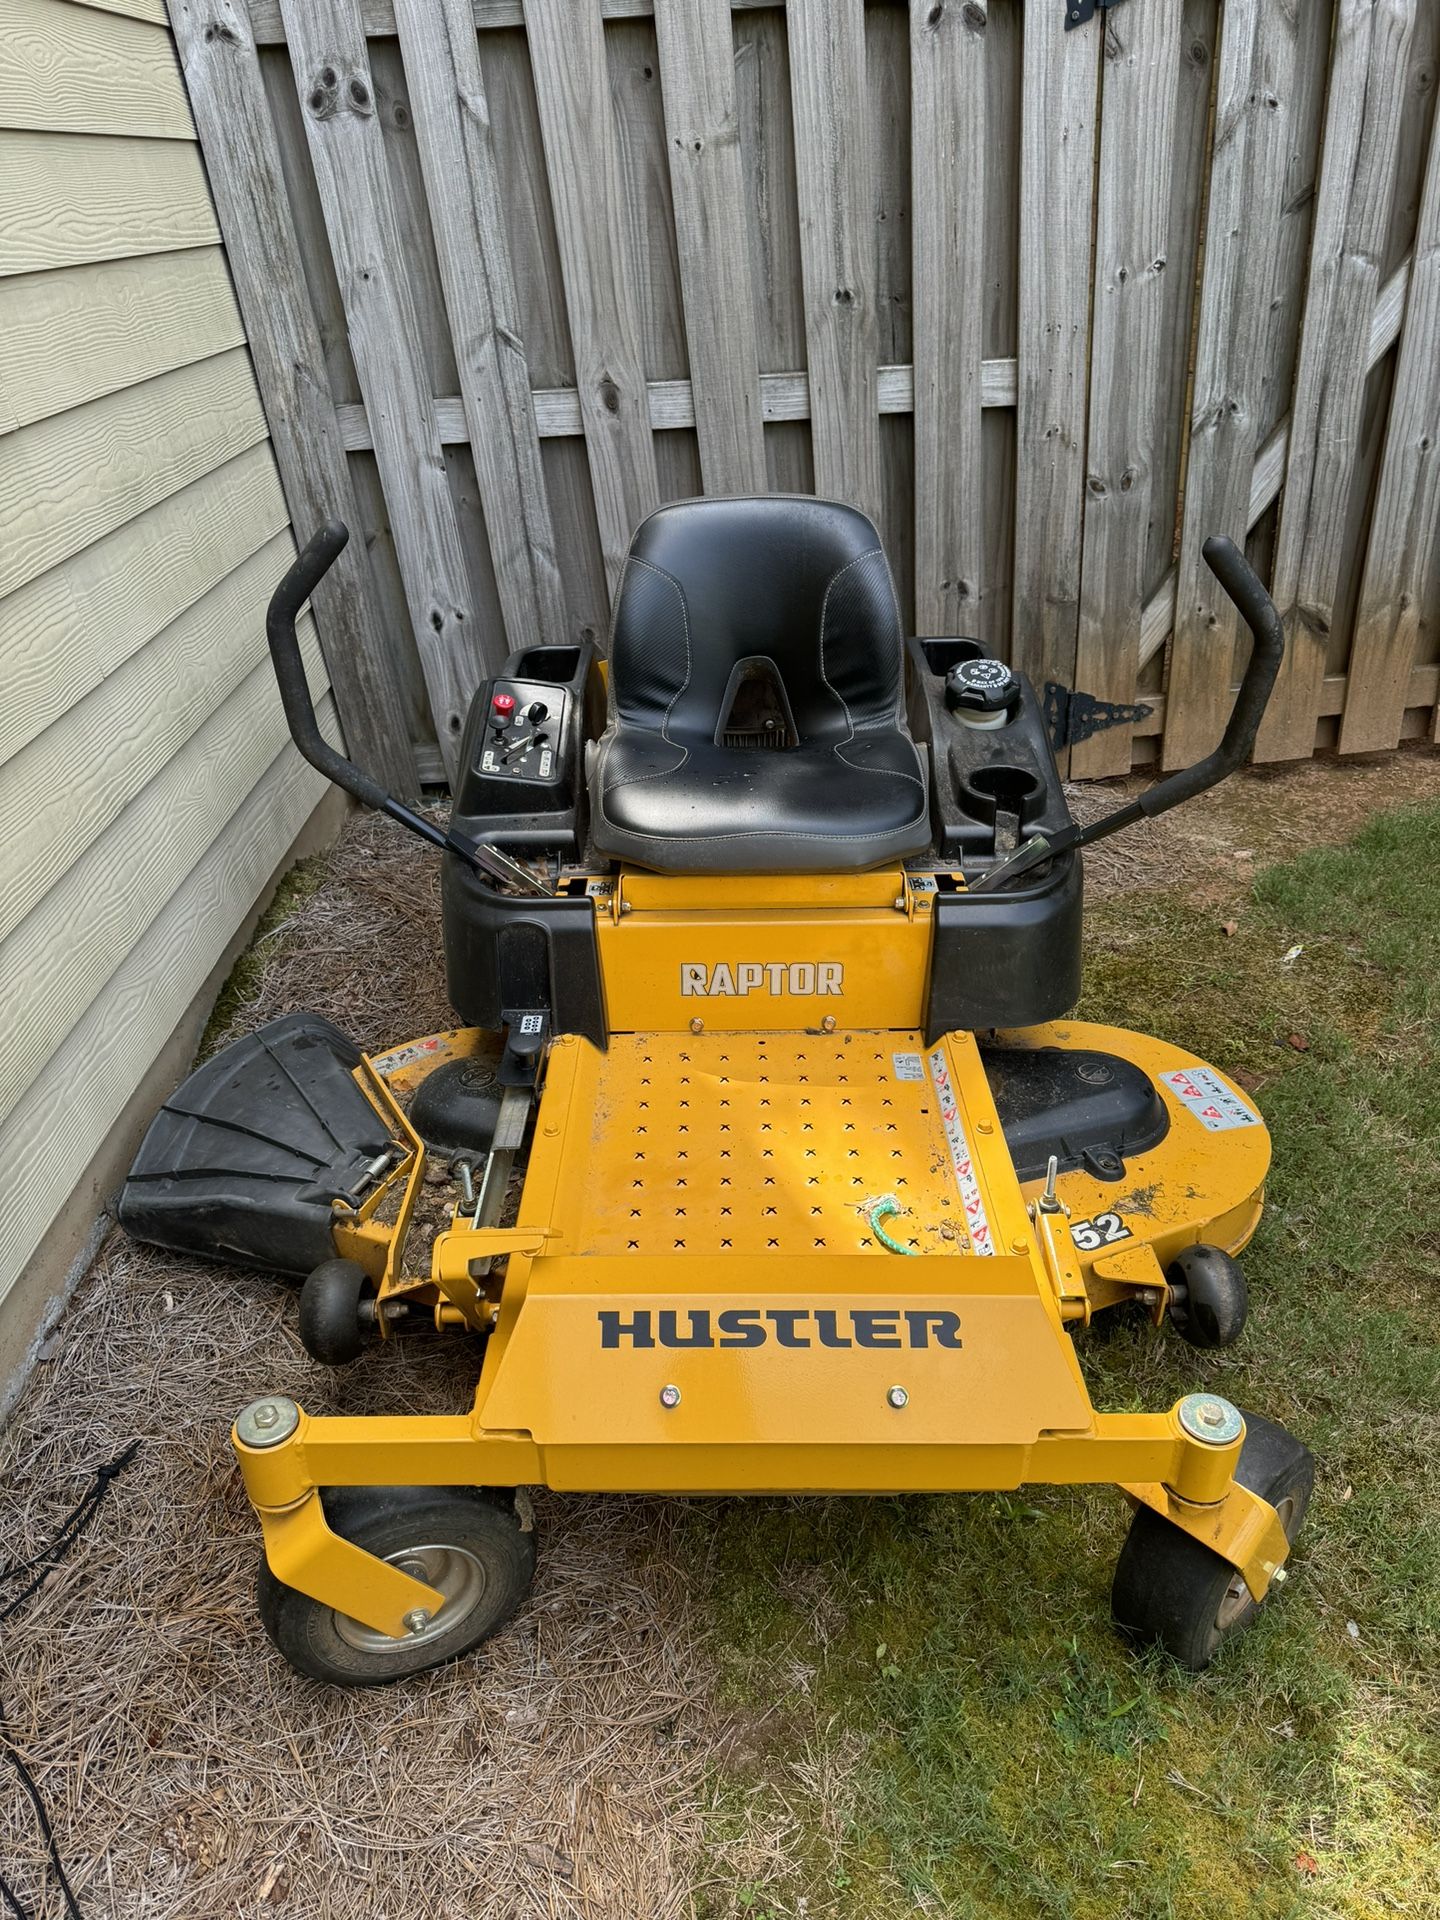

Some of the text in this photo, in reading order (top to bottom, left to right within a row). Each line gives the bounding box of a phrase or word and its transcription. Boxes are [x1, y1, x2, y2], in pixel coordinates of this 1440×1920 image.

[680, 962, 844, 997] RAPTOR
[1069, 1213, 1132, 1250] 52
[597, 1310, 963, 1349] HUSTLER
